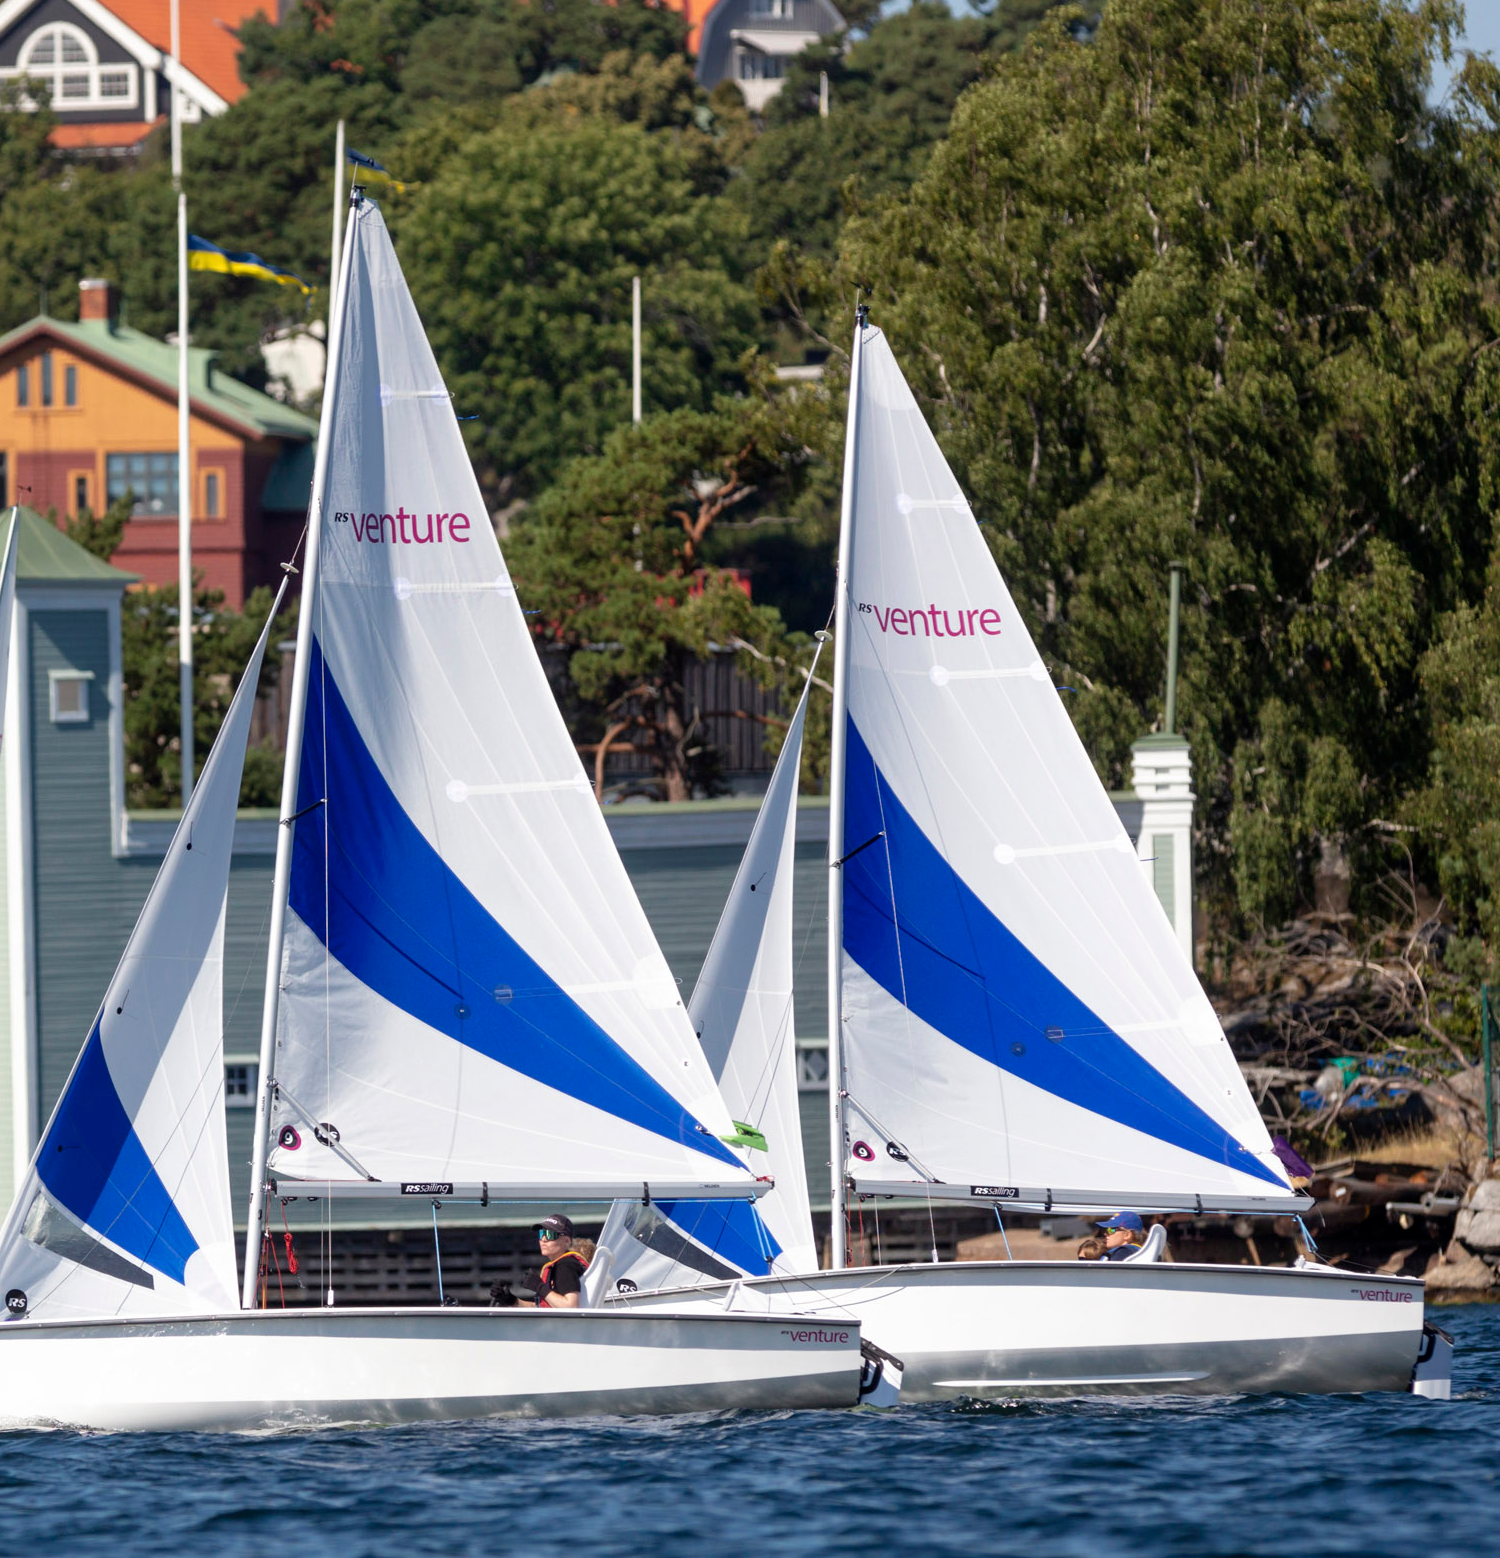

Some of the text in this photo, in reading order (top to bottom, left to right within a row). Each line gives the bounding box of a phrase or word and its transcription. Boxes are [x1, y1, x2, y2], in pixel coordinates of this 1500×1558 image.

[334, 507, 470, 543] RS venture
[858, 603, 1001, 637] RS venture
[8, 1297, 26, 1308] RS
[1359, 1288, 1413, 1303] venture
[790, 1329, 849, 1343] venture
